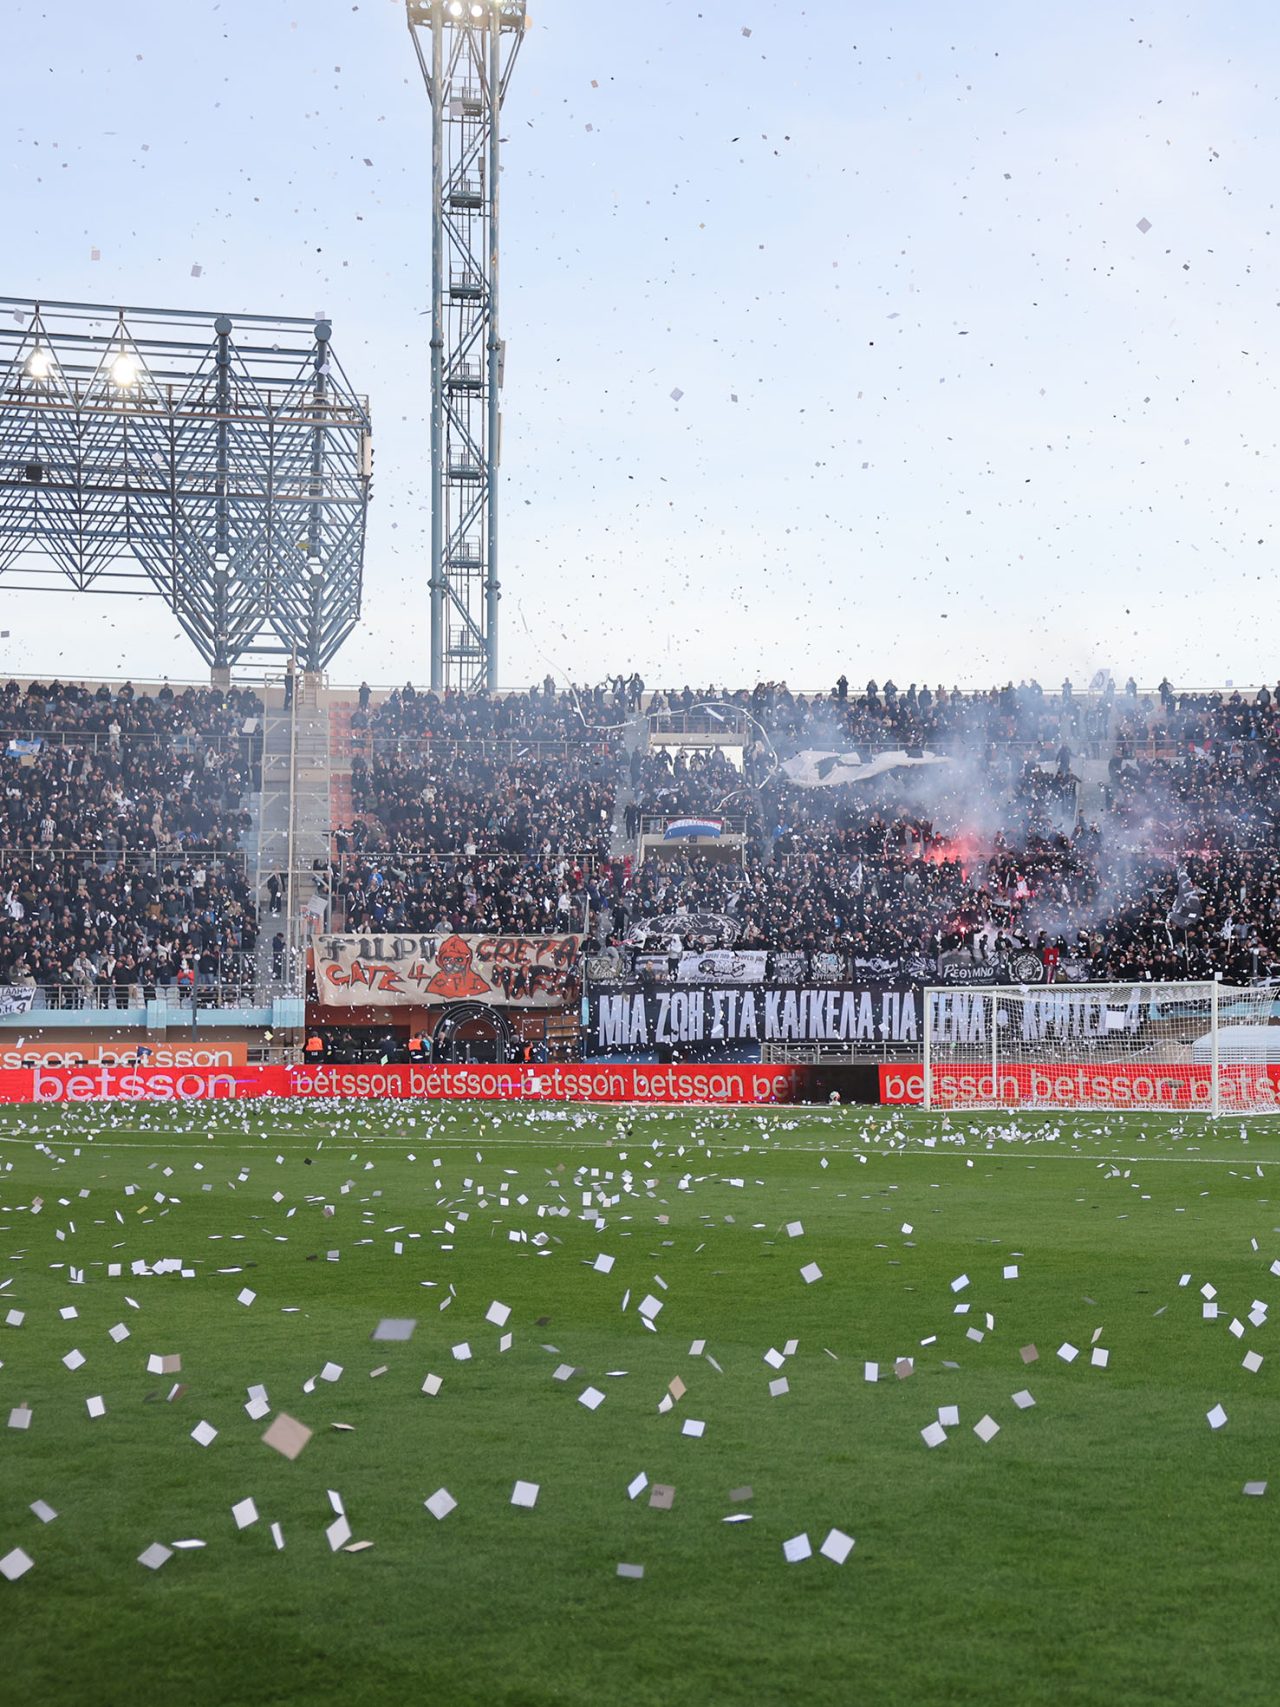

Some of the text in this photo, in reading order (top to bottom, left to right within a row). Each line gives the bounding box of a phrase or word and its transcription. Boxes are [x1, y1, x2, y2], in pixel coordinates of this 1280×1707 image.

[408, 961, 431, 988] 4
[599, 993, 648, 1046] ΜΙΑ
[655, 991, 704, 1043] ΖΩΗ
[711, 990, 757, 1039] ΣΤΑ
[98, 1046, 233, 1068] betsson
[33, 1069, 236, 1101] betsson
[297, 1069, 401, 1094] betsson
[411, 1068, 512, 1095] betsson
[521, 1069, 625, 1096] betsson
[633, 1069, 744, 1098] betsson
[1031, 1068, 1177, 1101] betsson
